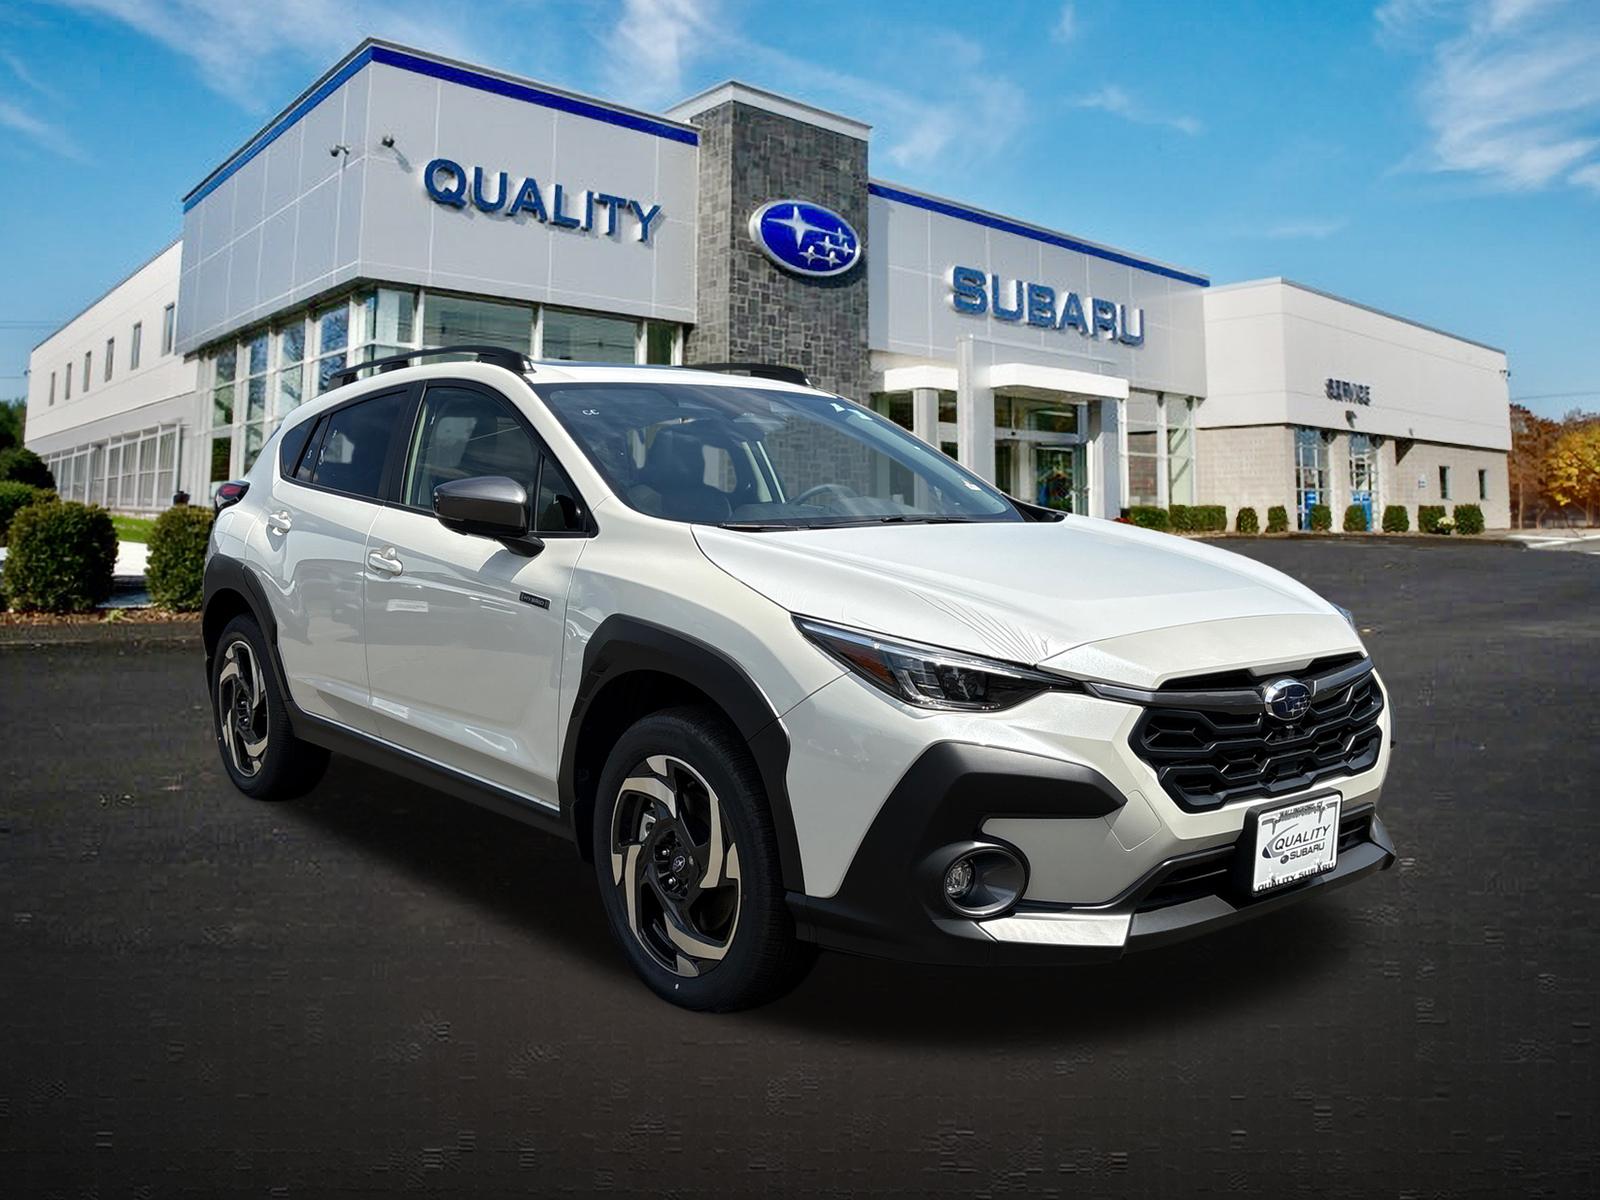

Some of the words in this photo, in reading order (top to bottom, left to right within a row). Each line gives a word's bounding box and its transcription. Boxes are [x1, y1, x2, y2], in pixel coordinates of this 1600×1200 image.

[424, 158, 661, 242] QUALITY
[951, 264, 1145, 346] SUBARU
[1325, 378, 1371, 406] SERVICE
[1274, 823, 1331, 851] QUALITY
[1290, 841, 1325, 860] SUBARU
[1257, 873, 1296, 891] QUALITY
[1298, 862, 1335, 878] SUBARU
